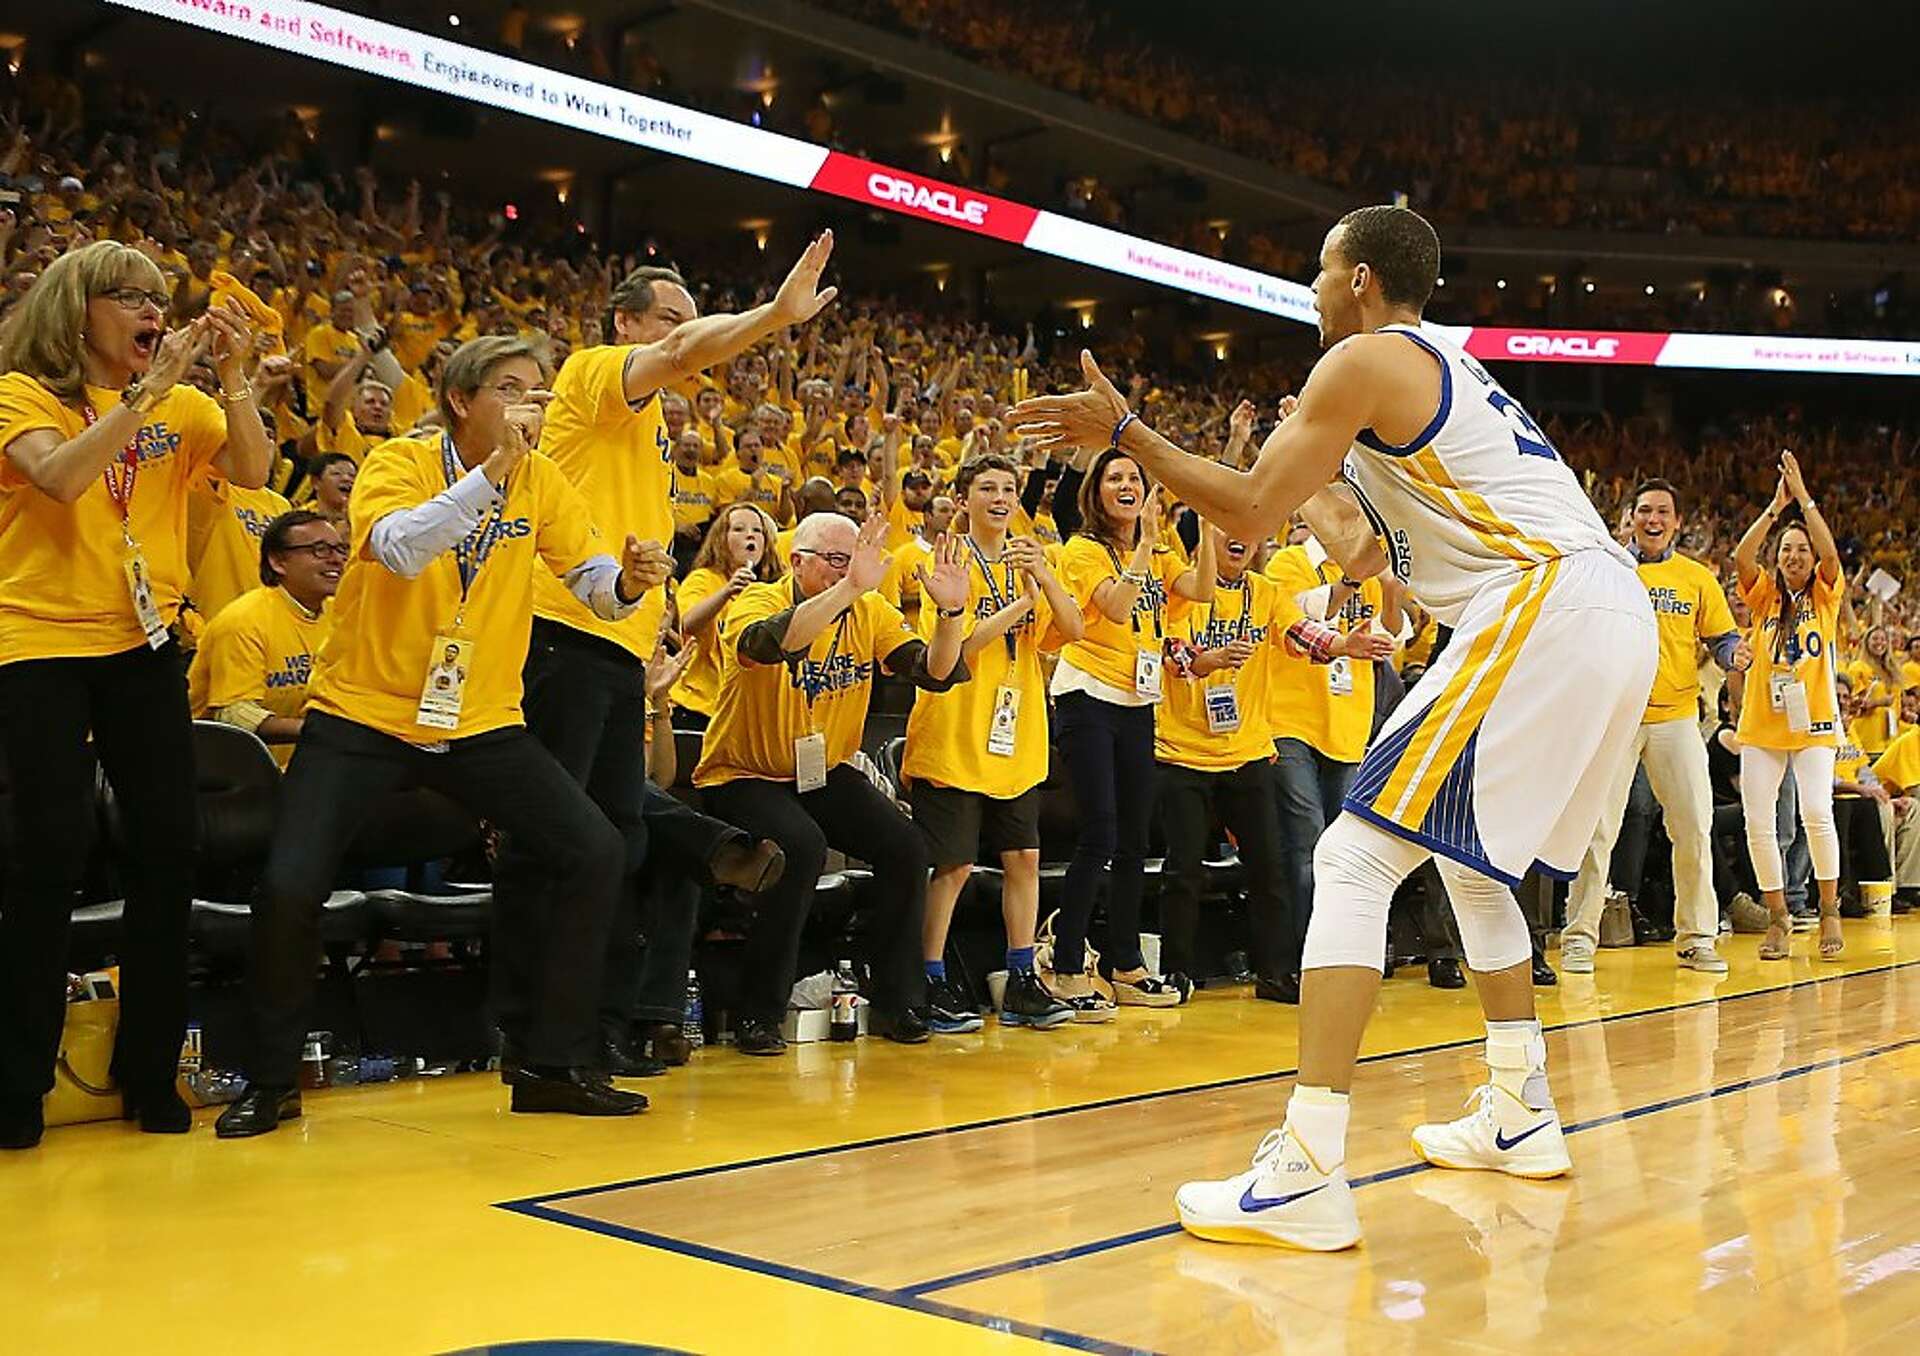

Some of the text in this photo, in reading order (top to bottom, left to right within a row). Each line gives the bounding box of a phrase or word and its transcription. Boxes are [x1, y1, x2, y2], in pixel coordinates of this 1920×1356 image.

[260, 12, 300, 36] and
[423, 51, 535, 99] Engineered
[541, 87, 559, 106] to
[564, 90, 609, 120] Work
[618, 104, 692, 141] Together
[867, 172, 989, 225] ORACLE
[1507, 335, 1619, 358] ORACLE
[1649, 587, 1677, 599] ARE
